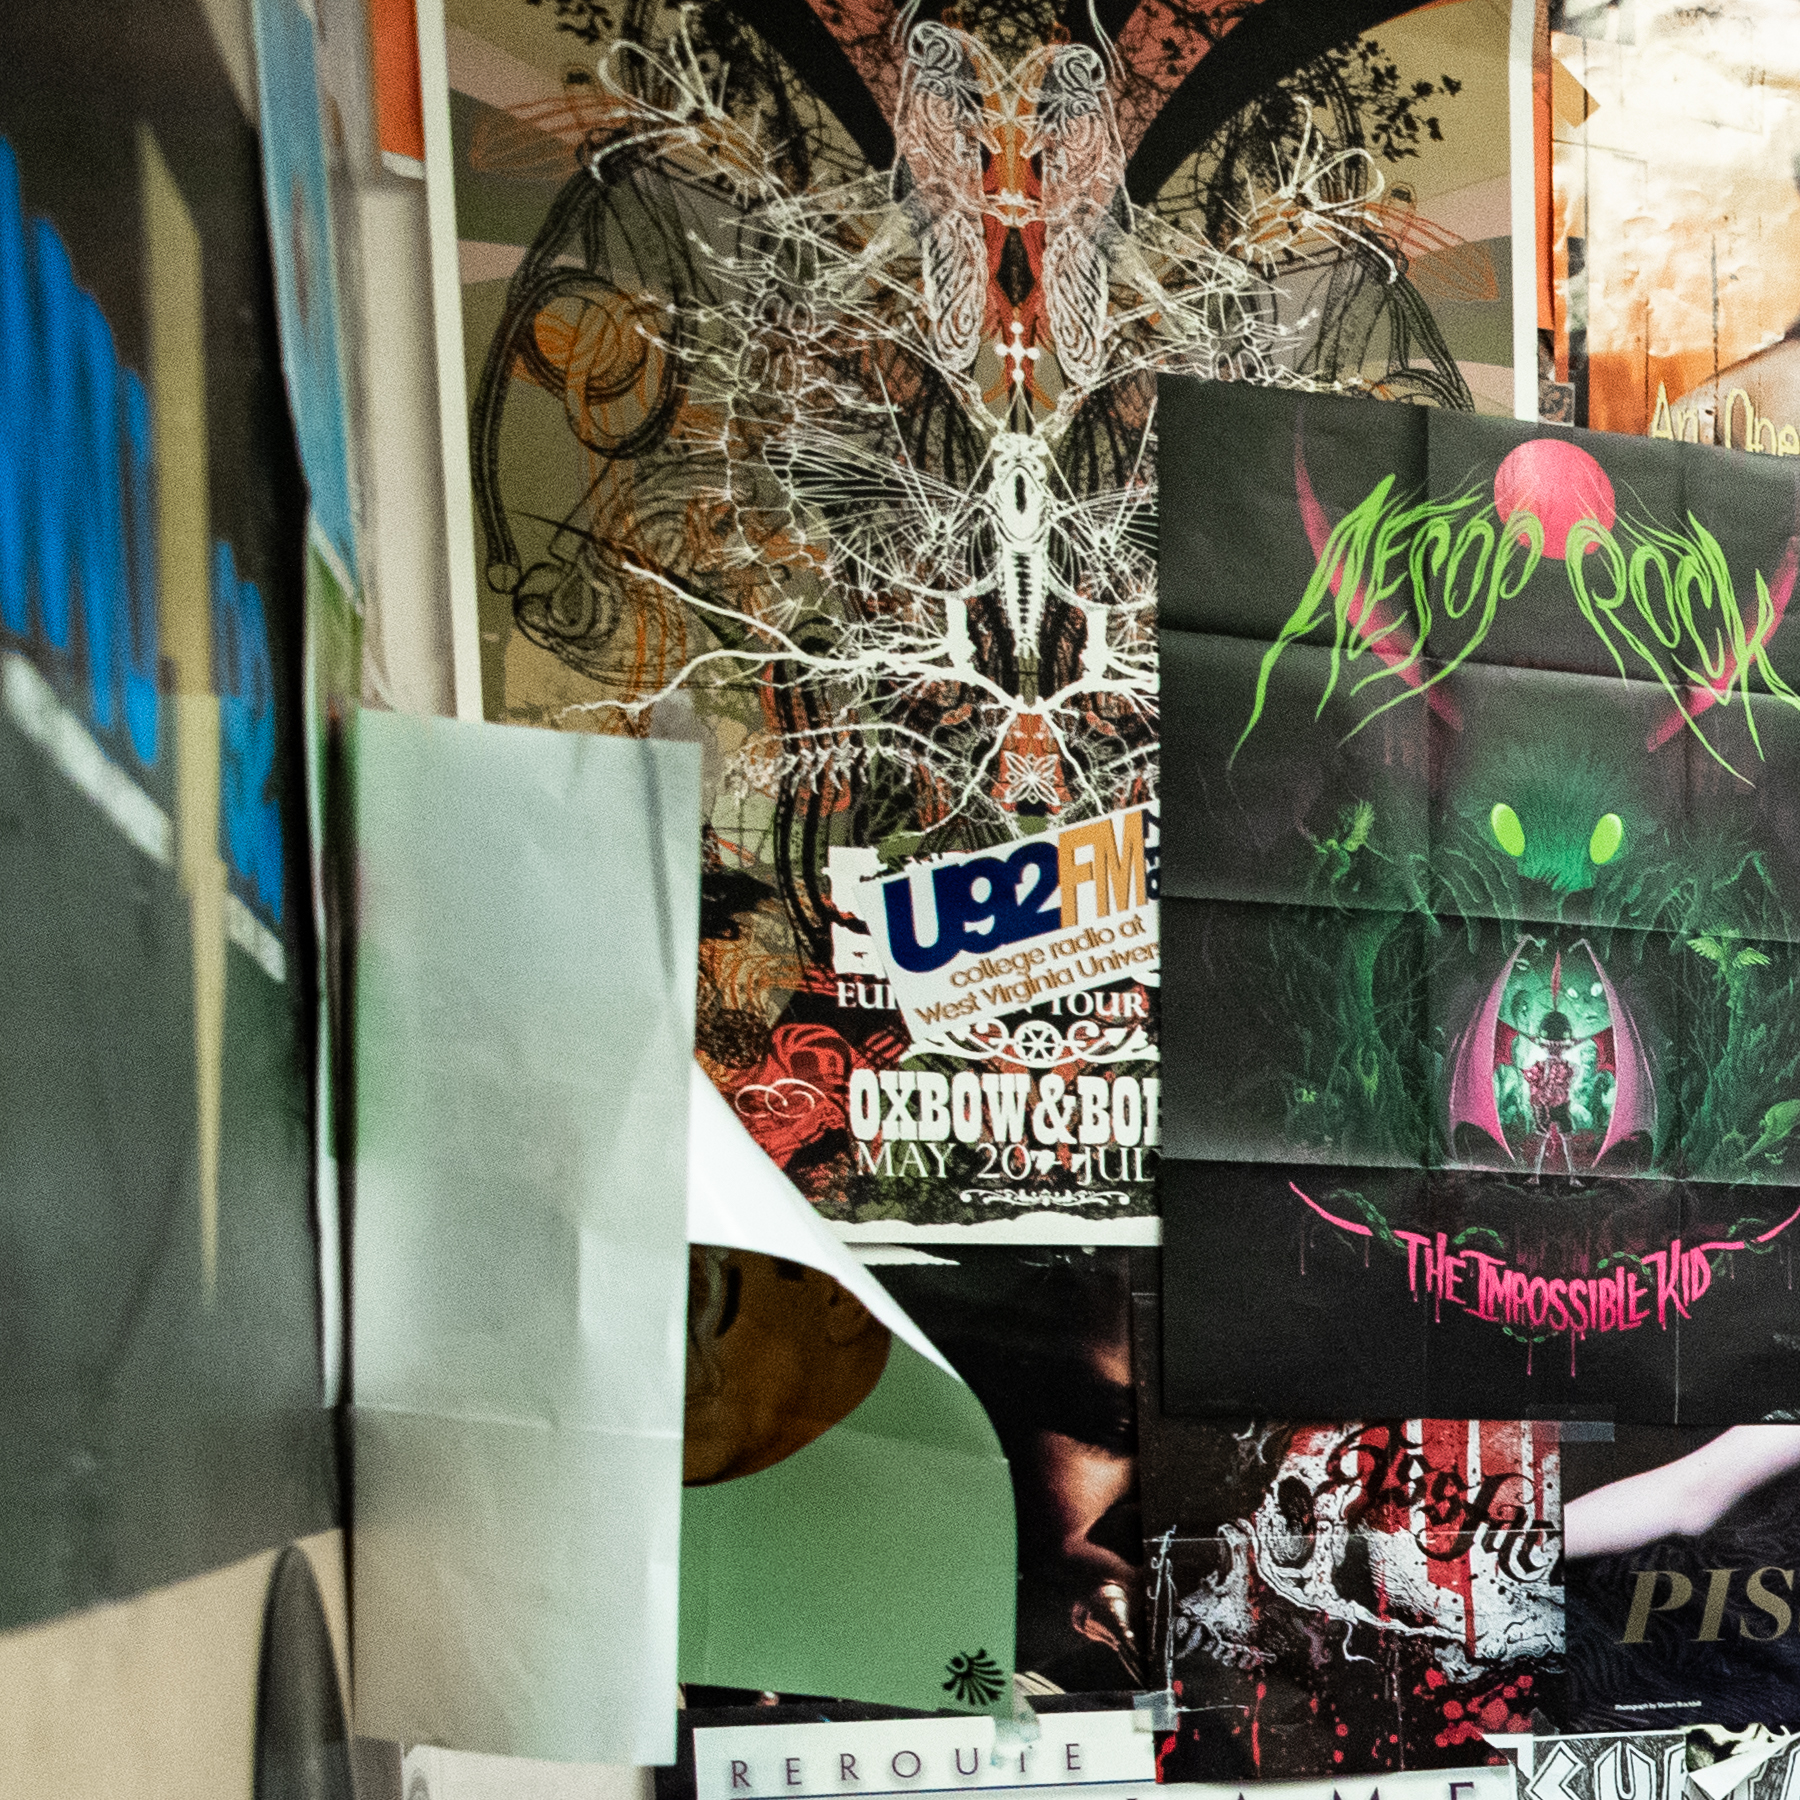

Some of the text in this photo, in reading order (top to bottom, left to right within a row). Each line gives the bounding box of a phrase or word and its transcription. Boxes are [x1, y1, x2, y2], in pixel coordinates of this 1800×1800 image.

[949, 913, 1146, 990] college radio at
[914, 962, 1075, 1027] West Virginia
[856, 1142, 957, 1179] MAY
[1394, 1229, 1745, 1334] THE IMPOSSIBLE KID
